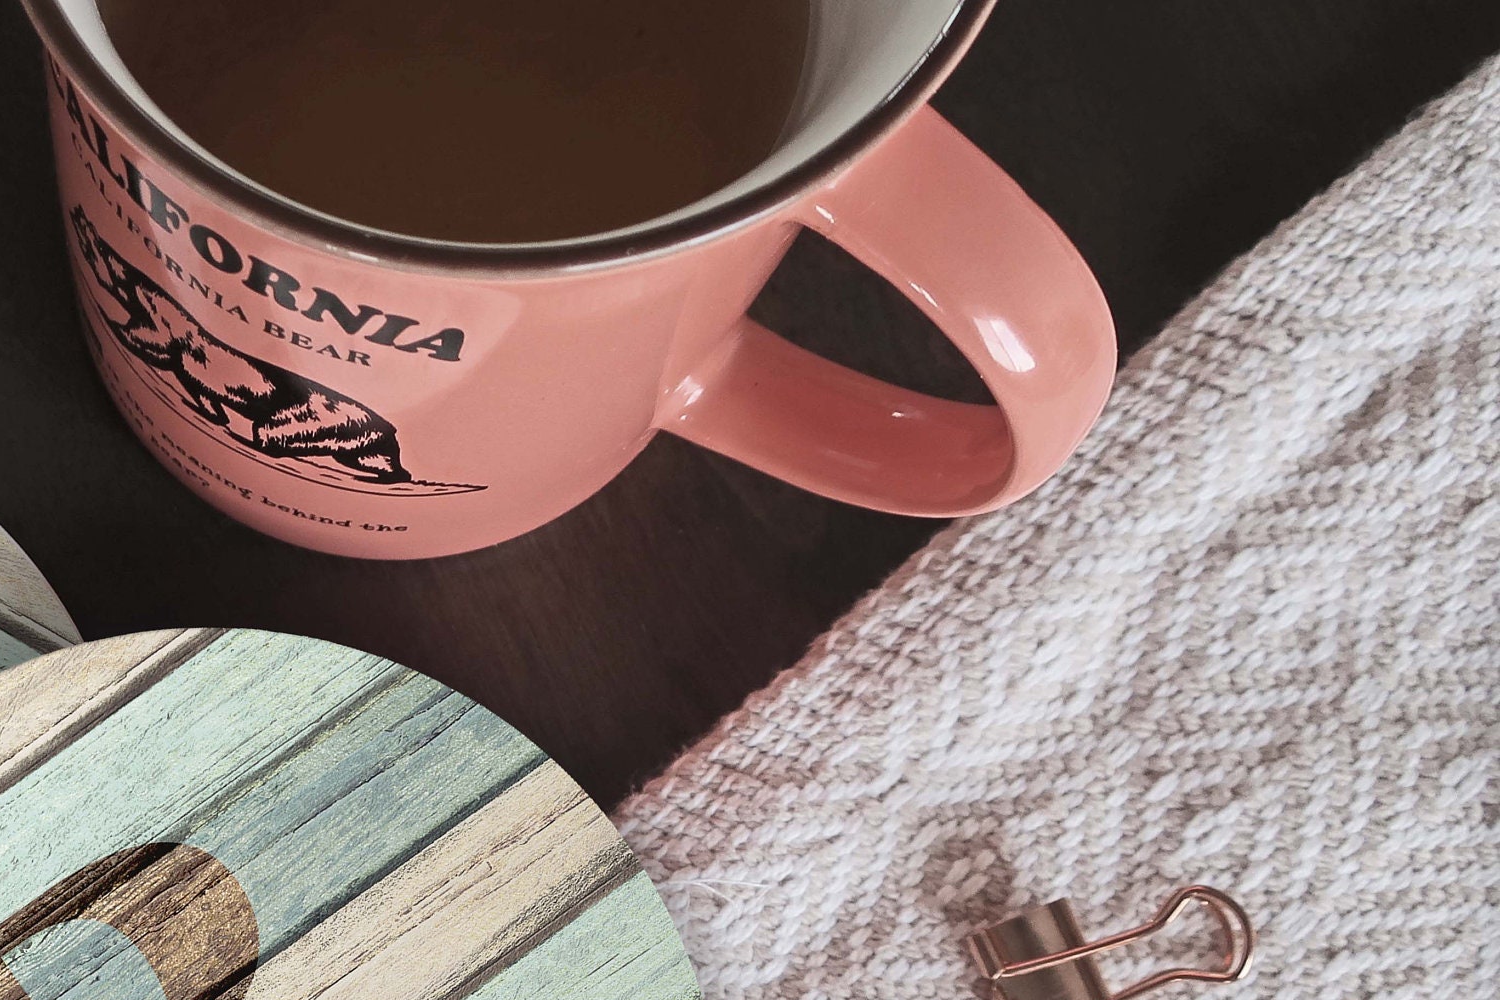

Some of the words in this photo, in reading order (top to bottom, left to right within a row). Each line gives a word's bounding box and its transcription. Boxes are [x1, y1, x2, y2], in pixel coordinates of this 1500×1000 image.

[263, 317, 372, 368] BEAR
[161, 431, 253, 500] meaning
[260, 496, 352, 528] behind
[359, 523, 408, 533] the
